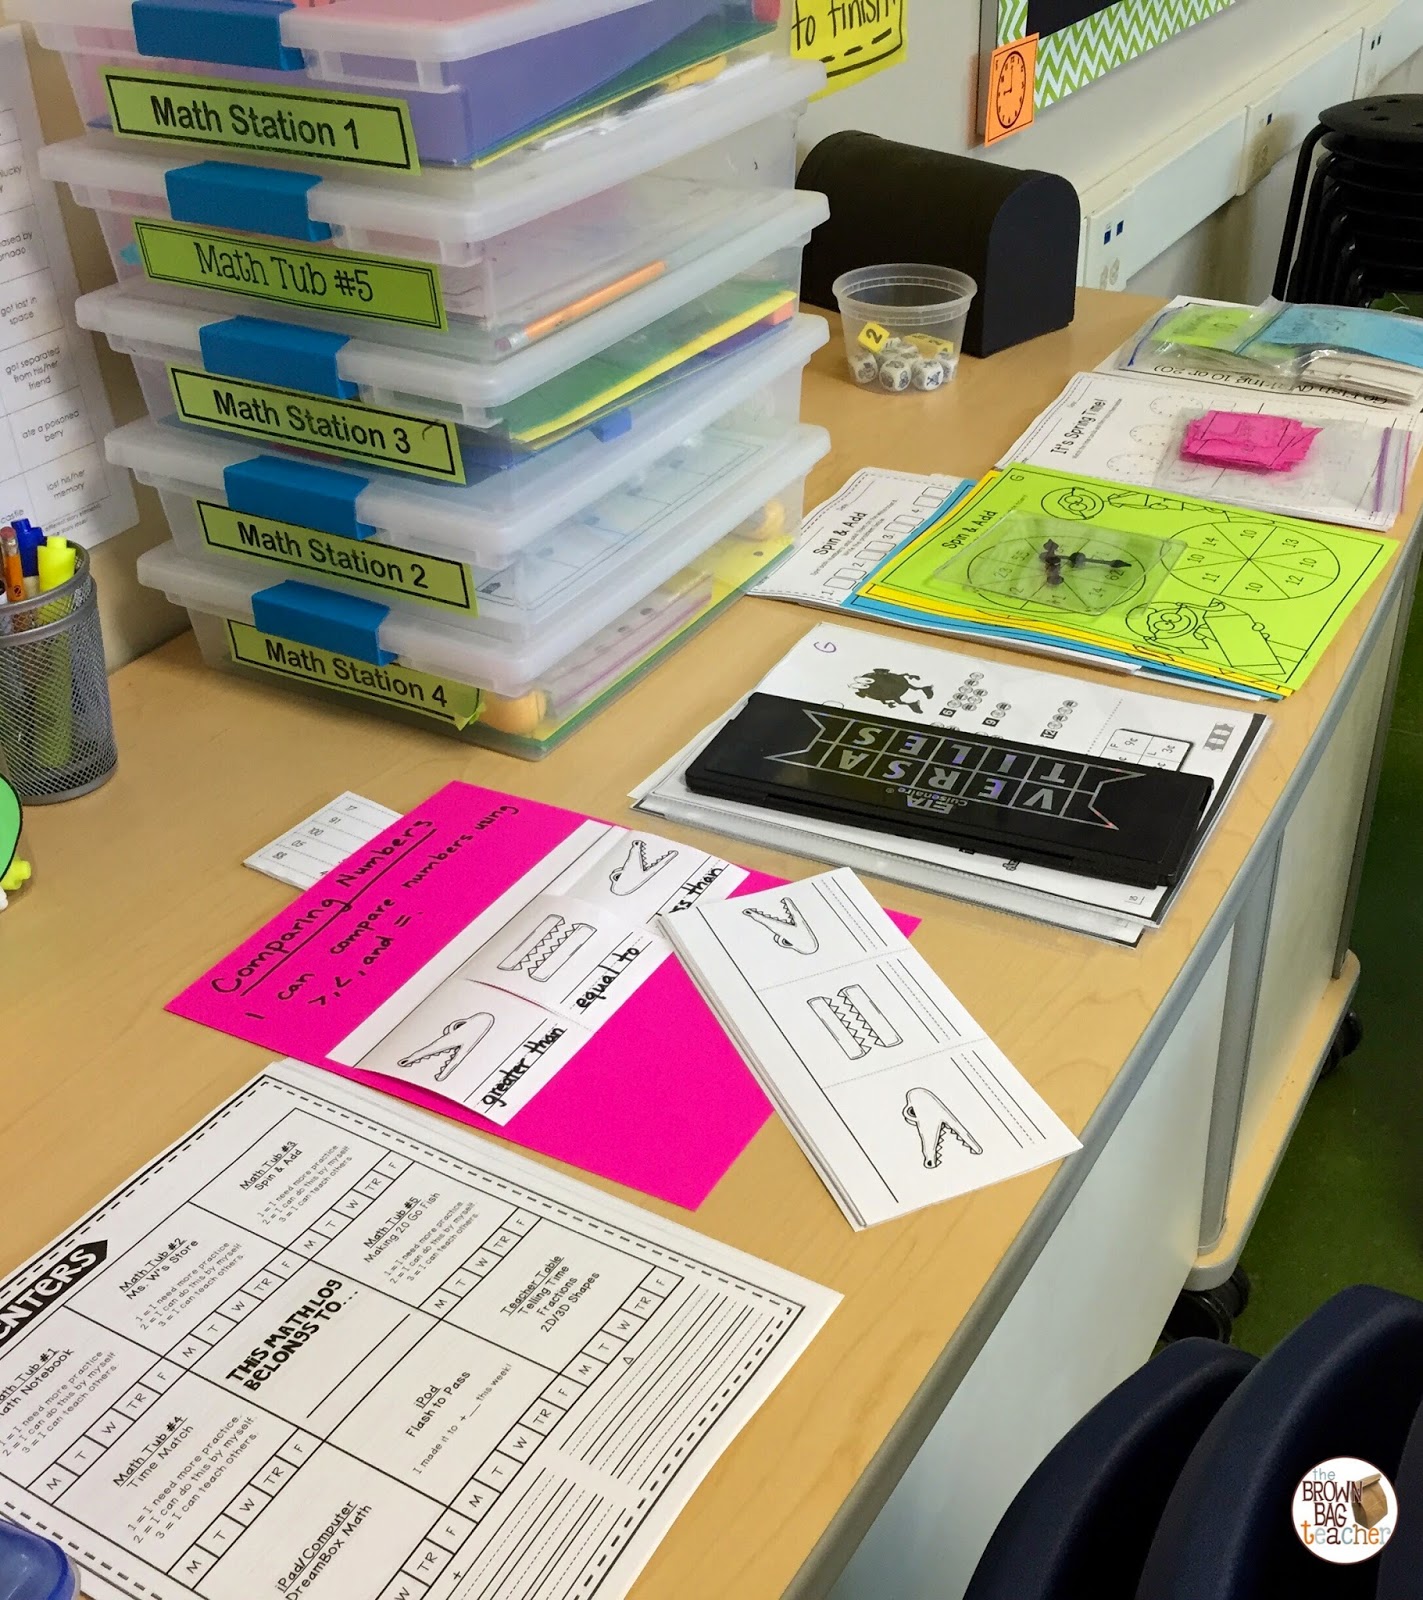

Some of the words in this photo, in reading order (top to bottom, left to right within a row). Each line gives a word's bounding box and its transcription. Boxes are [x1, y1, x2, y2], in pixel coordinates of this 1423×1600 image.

[792, 0, 815, 51] to
[150, 95, 223, 134] Math
[230, 104, 335, 147] Station
[343, 118, 359, 150] 1
[193, 242, 270, 287] Math
[270, 257, 326, 296] Tub
[335, 270, 373, 302] #5
[9, 310, 34, 325] space
[866, 328, 883, 344] 2
[13, 371, 32, 383] from
[21, 347, 60, 367] separated
[28, 376, 51, 390] friend
[44, 429, 64, 442] berry
[45, 410, 80, 430] poisoned
[213, 389, 280, 427] Math
[286, 409, 385, 450] Station
[395, 428, 410, 454] 3
[53, 482, 85, 499] memory
[238, 521, 301, 558] Math
[309, 540, 400, 583] Station
[411, 564, 428, 589] 2
[812, 534, 839, 556] Spin
[848, 511, 869, 534] Add
[942, 532, 968, 550] Spin
[972, 510, 998, 526] Add
[266, 638, 333, 674] Math
[335, 658, 423, 701] Station
[432, 686, 447, 707] 4
[211, 897, 354, 995] Comparing
[336, 819, 433, 888] Numbers
[277, 973, 315, 1000] can
[330, 898, 395, 956] compare
[402, 833, 473, 889] numbers
[363, 935, 395, 966] and
[576, 964, 620, 1009] equal
[612, 946, 640, 965] to
[481, 1058, 529, 1107] greater
[524, 1025, 565, 1058] than
[240, 1167, 265, 1190] Math
[262, 1153, 282, 1169] Tub
[282, 1141, 297, 1153] #3
[255, 1174, 276, 1190] Spin
[283, 1149, 302, 1167] Add
[304, 1240, 316, 1250] M
[325, 1220, 337, 1229] T
[346, 1200, 359, 1209] W
[365, 1178, 382, 1192] TR
[388, 1162, 397, 1170] F
[363, 1226, 388, 1248] Math
[388, 1210, 406, 1226] Tub
[404, 1196, 419, 1209] #5
[364, 1235, 399, 1263] Making
[396, 1222, 410, 1233] 20
[408, 1209, 423, 1221] Go
[421, 1192, 441, 1210] Fish
[119, 1269, 148, 1291] Math
[144, 1251, 169, 1268] Tub
[168, 1237, 186, 1251] #2
[126, 1284, 149, 1300] Ms.
[146, 1264, 169, 1282] W's
[169, 1240, 199, 1264] Store
[500, 1281, 537, 1315] Teacher
[535, 1255, 563, 1280] Table
[517, 1287, 551, 1315] Telling
[546, 1265, 570, 1286] Time
[536, 1277, 578, 1316] Fractions
[541, 1304, 570, 1333] 2D/3D
[568, 1272, 600, 1303] Shapes
[0, 1385, 17, 1401] ath
[14, 1363, 40, 1382] Tub
[39, 1348, 59, 1362] #1
[20, 1349, 74, 1395] Notebook
[413, 1385, 438, 1409] iPod
[405, 1409, 435, 1438] Flash
[433, 1397, 446, 1409] to
[444, 1371, 471, 1395] Pass
[421, 1442, 442, 1468] made
[447, 1425, 458, 1435] to
[476, 1388, 493, 1401] this
[112, 1456, 145, 1487] Math
[141, 1433, 167, 1454] Tub
[166, 1415, 183, 1432] #4
[126, 1461, 159, 1489] Time
[158, 1425, 194, 1460] Match
[153, 1481, 177, 1505] need
[177, 1454, 202, 1481] more
[161, 1496, 179, 1516] can
[180, 1483, 192, 1496] do
[192, 1464, 211, 1487] this
[211, 1450, 224, 1464] by
[182, 1493, 200, 1513] can
[199, 1464, 227, 1493] teach
[186, 1560, 202, 1574] M
[213, 1530, 228, 1542] T
[239, 1498, 255, 1513] W
[263, 1466, 285, 1486] TR
[294, 1444, 303, 1453] F
[275, 1501, 354, 1593] iPad/Computer
[285, 1538, 345, 1600] DreamBox
[342, 1504, 372, 1536] Math
